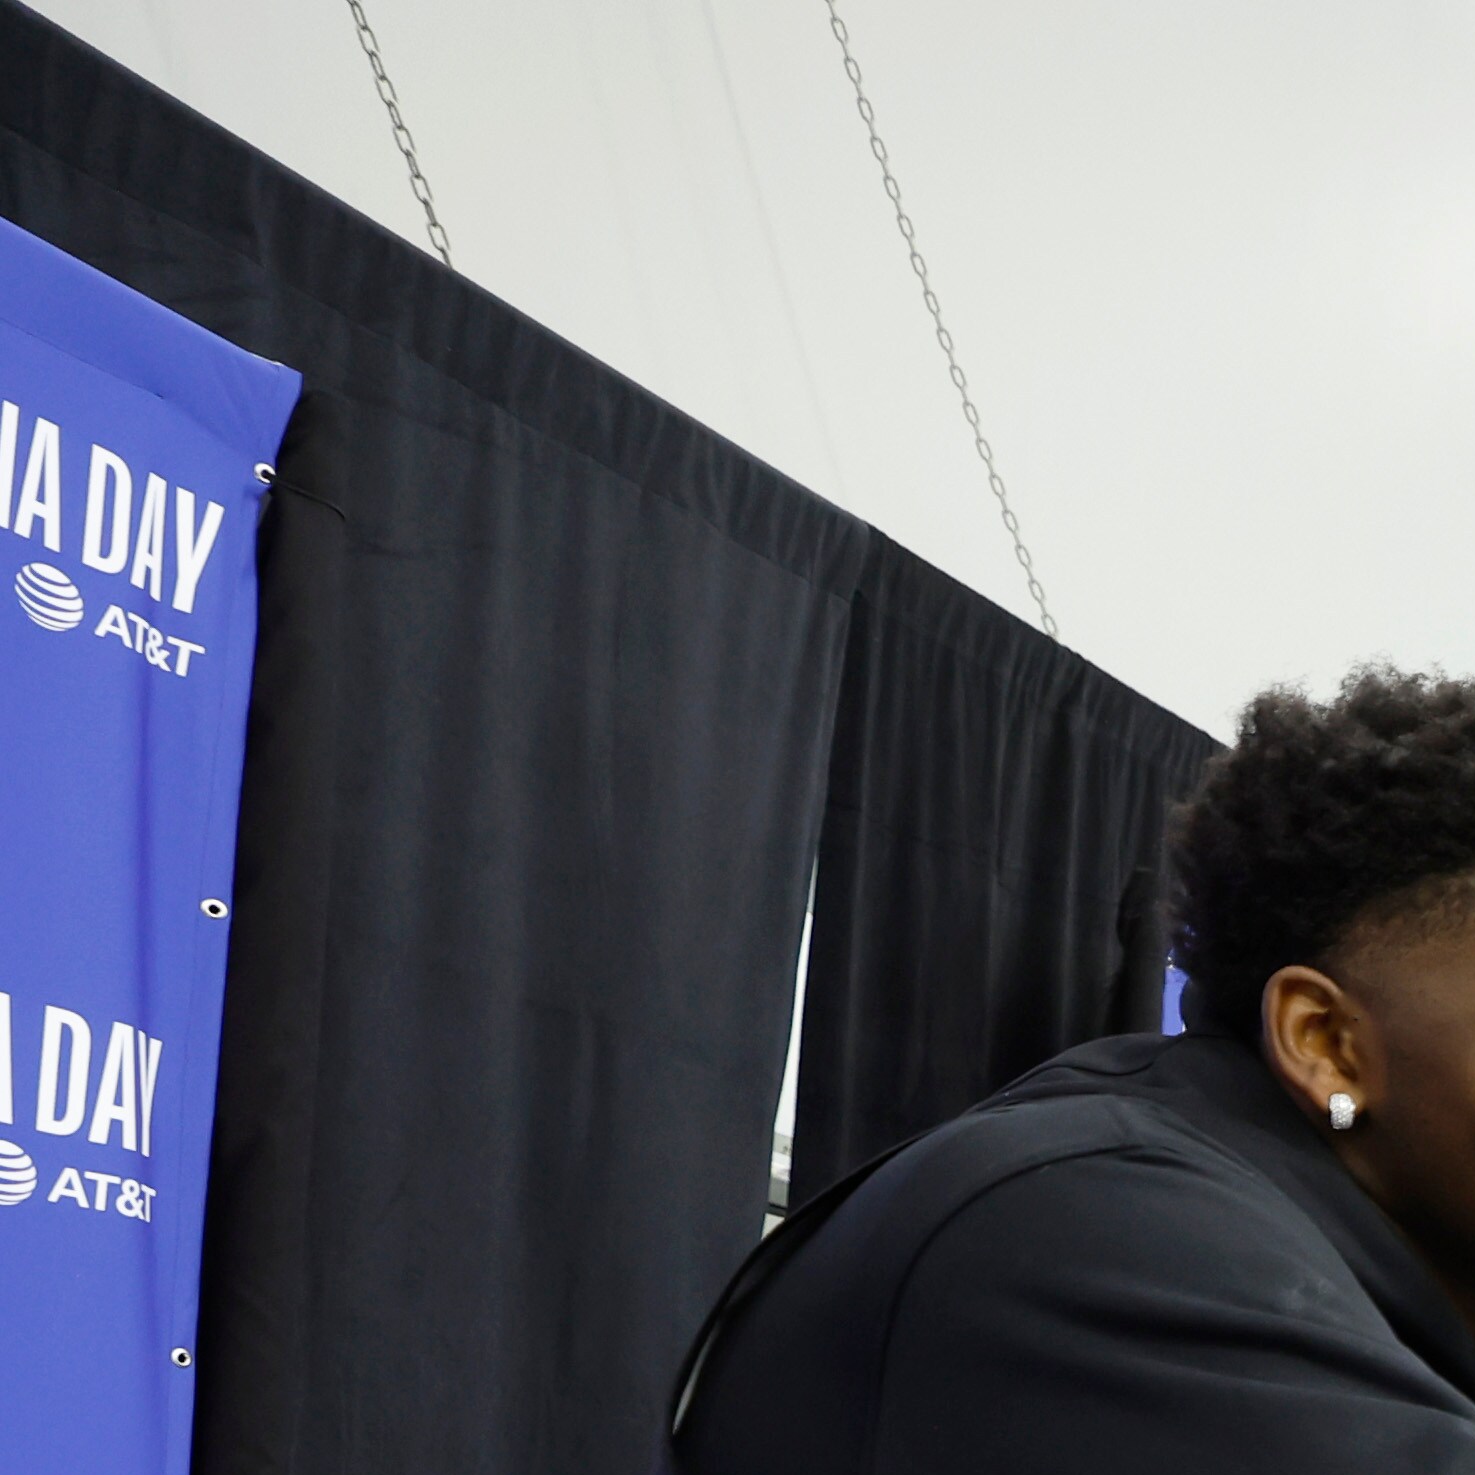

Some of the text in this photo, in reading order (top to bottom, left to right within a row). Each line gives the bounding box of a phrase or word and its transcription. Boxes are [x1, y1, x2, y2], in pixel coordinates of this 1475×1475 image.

[82, 443, 225, 614] DAY
[95, 605, 205, 677] AT&T
[35, 1004, 163, 1158] DAY
[47, 1166, 156, 1224] AT&T
